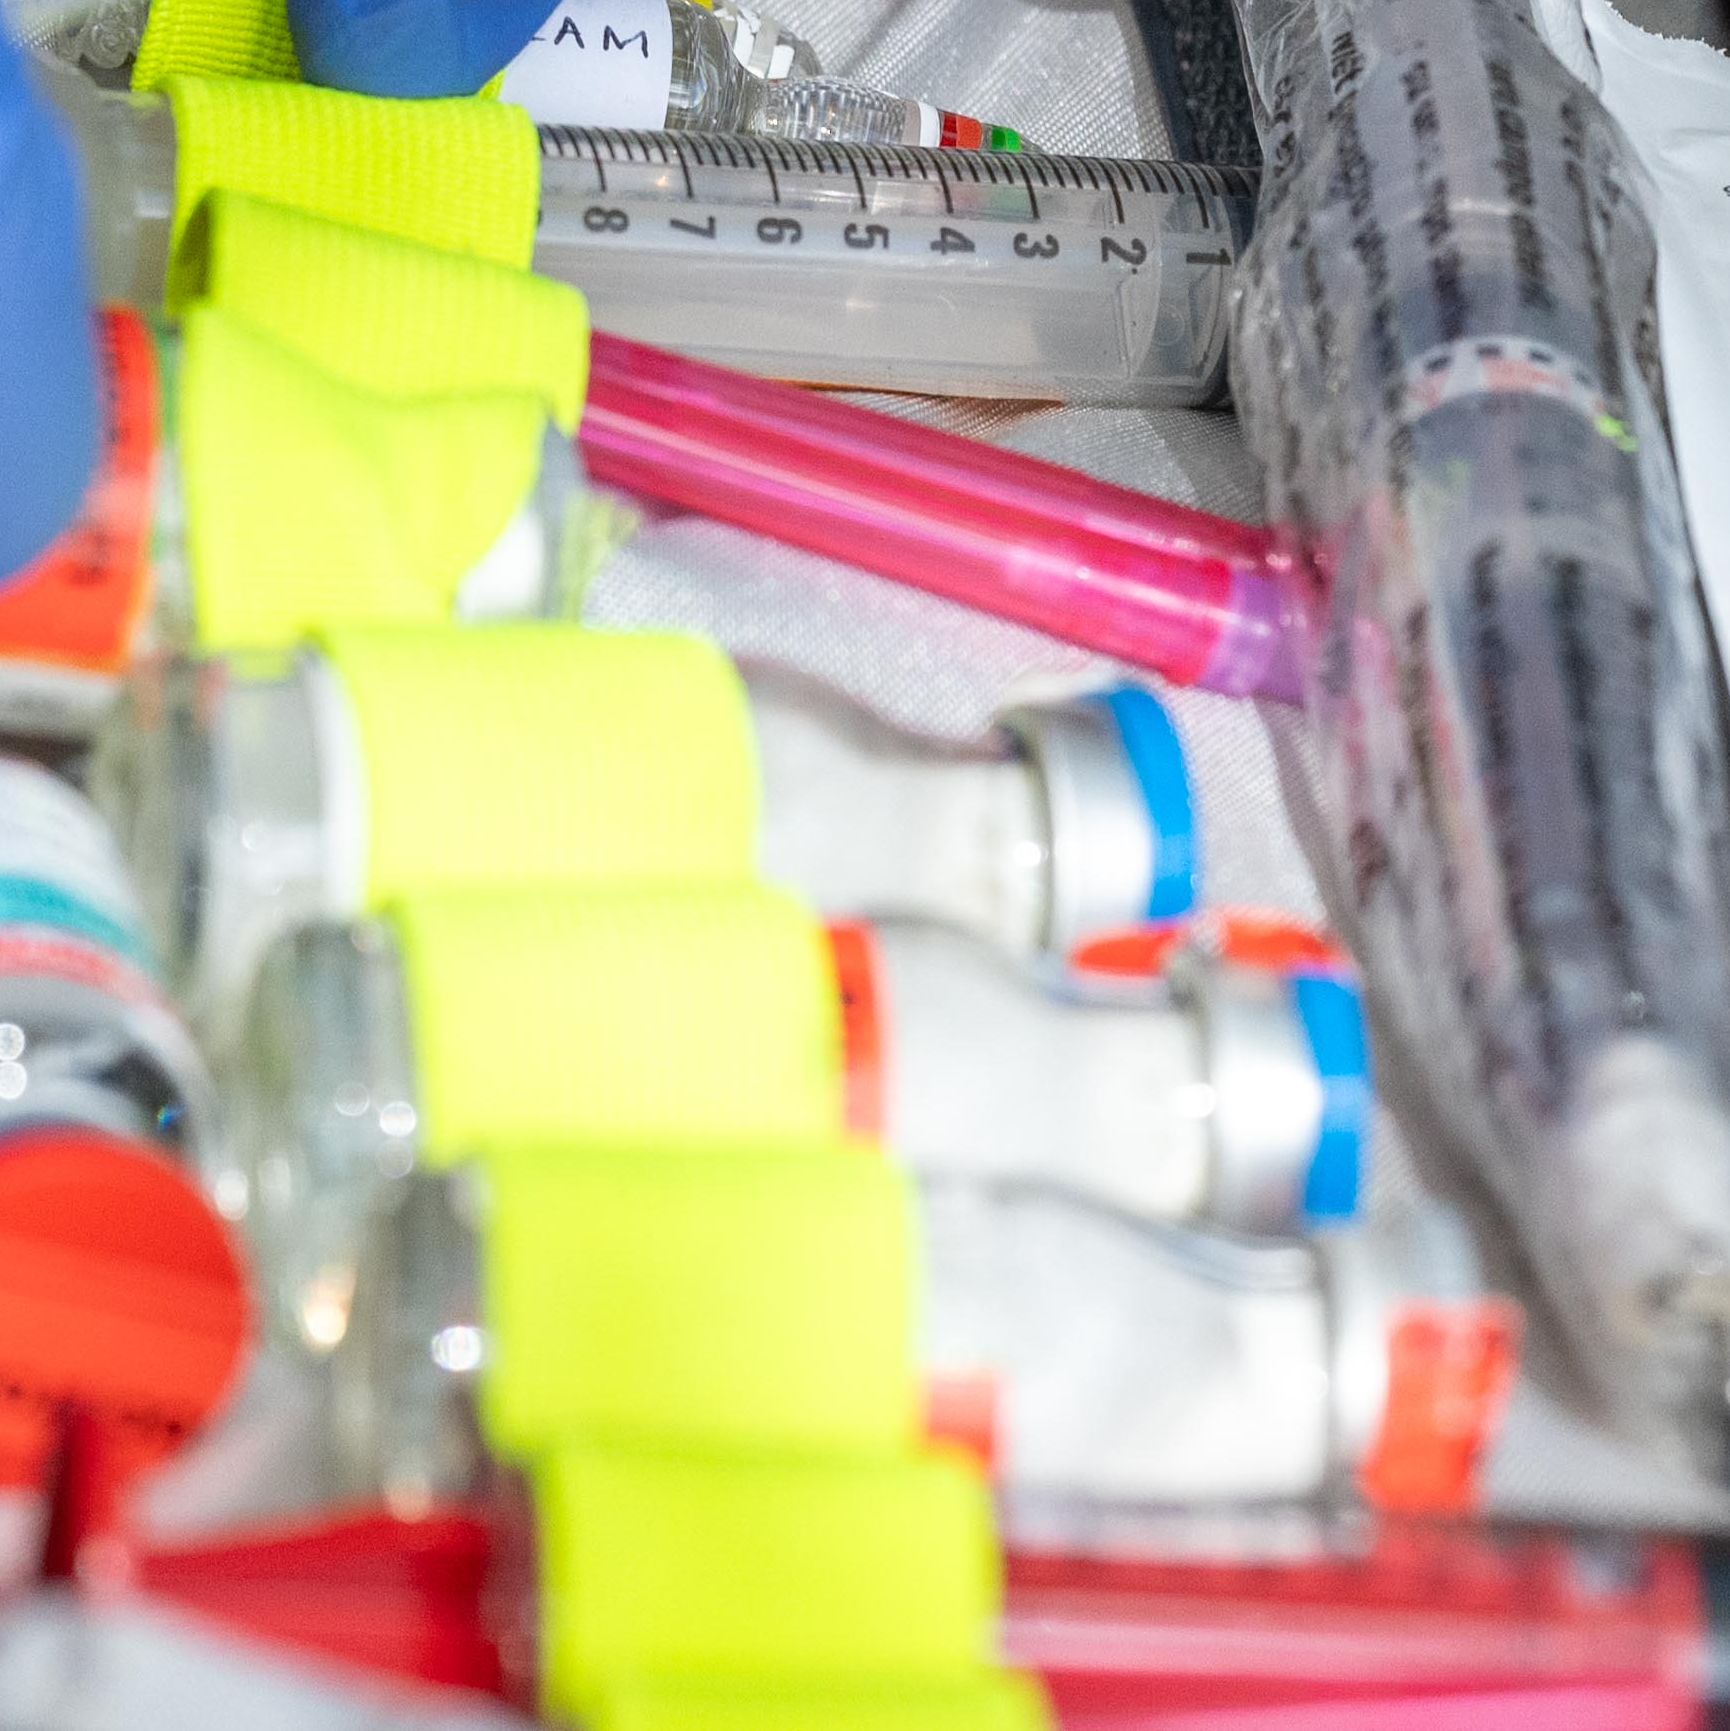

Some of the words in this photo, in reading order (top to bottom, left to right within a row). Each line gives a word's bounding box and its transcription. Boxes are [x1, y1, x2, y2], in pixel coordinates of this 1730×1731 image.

[582, 206, 629, 234] 8
[670, 215, 716, 241] 7
[756, 216, 803, 245] 6
[843, 223, 890, 252] 5
[929, 226, 976, 255] 4
[1012, 233, 1059, 261] 3
[1099, 236, 1147, 268] 2
[1184, 248, 1232, 267] 1
